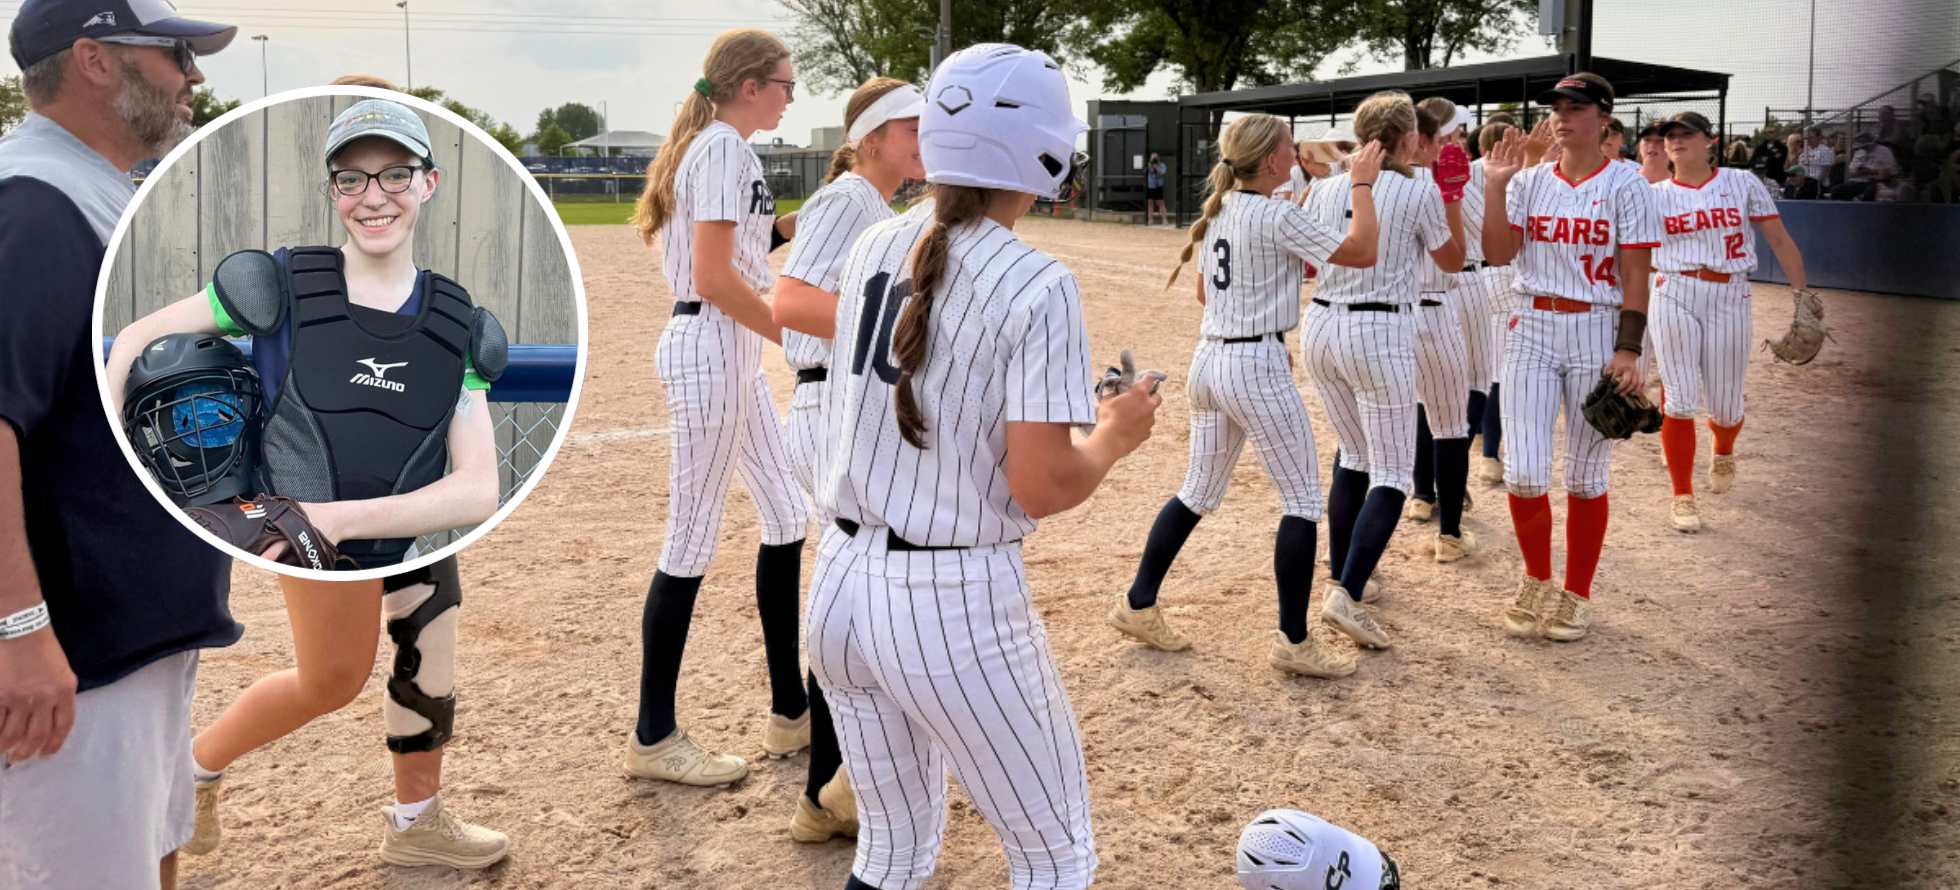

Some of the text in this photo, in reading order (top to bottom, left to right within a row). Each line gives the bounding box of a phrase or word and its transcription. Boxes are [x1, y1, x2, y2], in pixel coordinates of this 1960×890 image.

[1527, 215, 1610, 246] BEARS
[1664, 208, 1741, 235] BEARS
[1724, 232, 1746, 260] 12
[1213, 239, 1231, 290] 3
[1579, 254, 1617, 287] 14
[349, 373, 406, 393] MIZUNO
